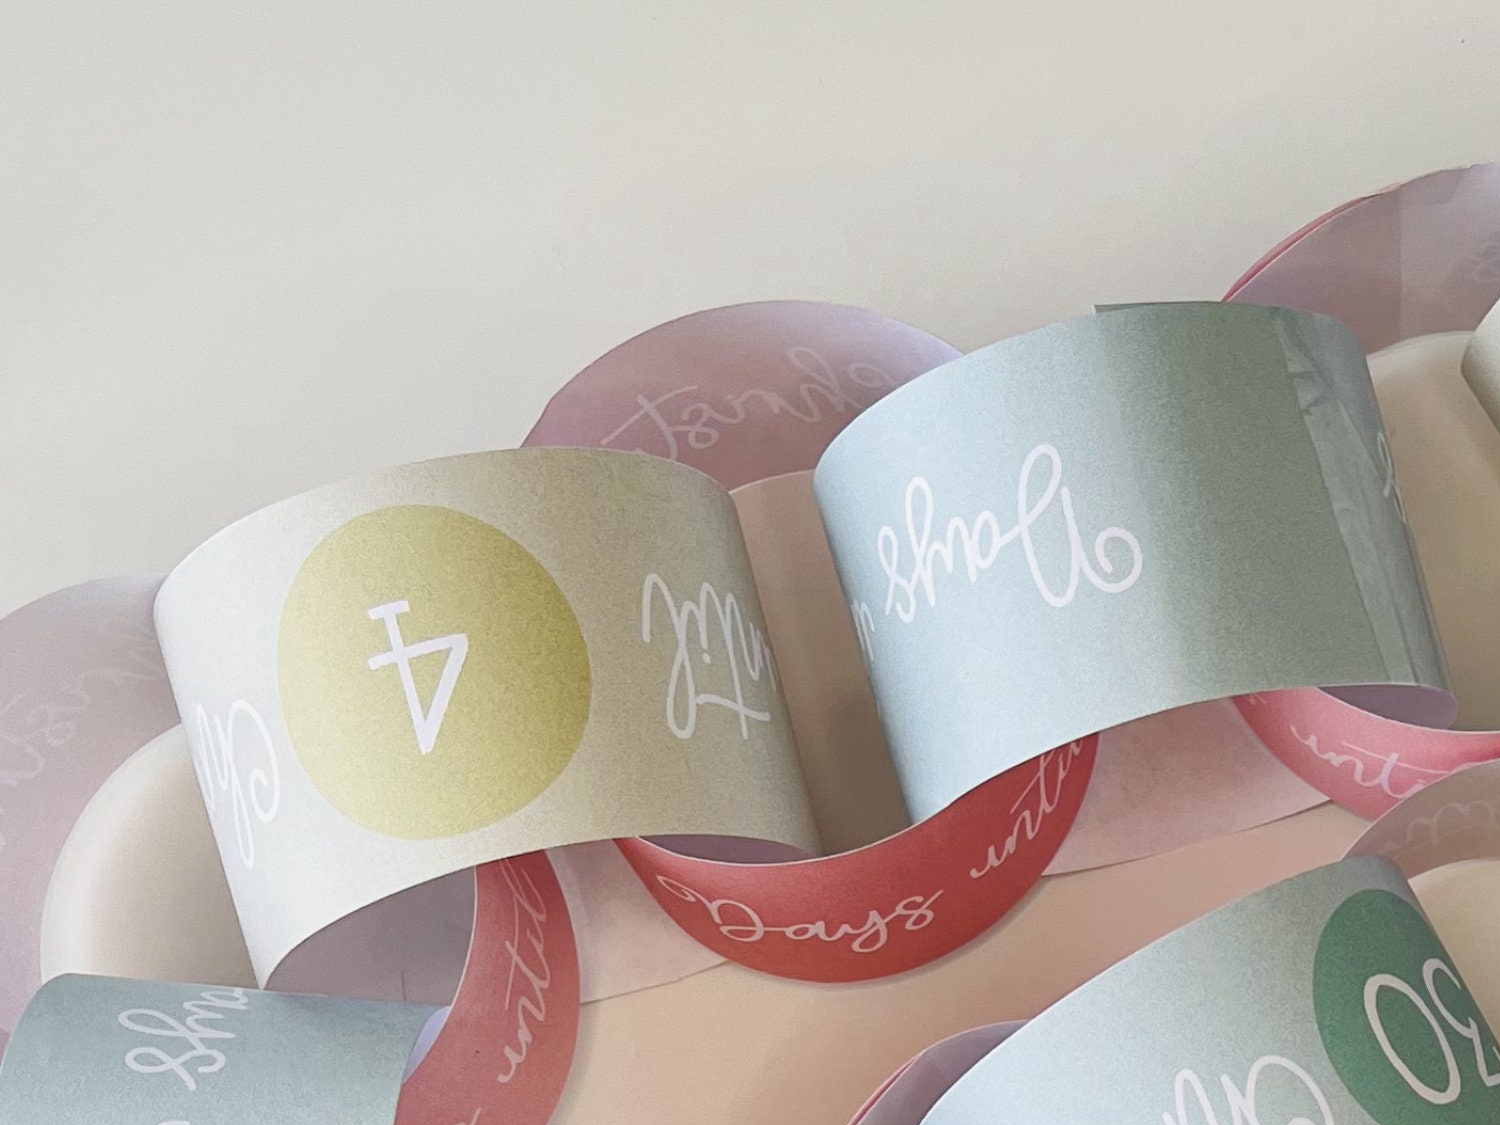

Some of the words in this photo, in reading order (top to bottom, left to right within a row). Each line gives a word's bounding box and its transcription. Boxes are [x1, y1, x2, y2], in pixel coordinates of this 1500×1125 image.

[878, 444, 1143, 623] Days
[367, 600, 468, 755] 4
[657, 874, 943, 954] Days
[118, 982, 248, 1090] ays
